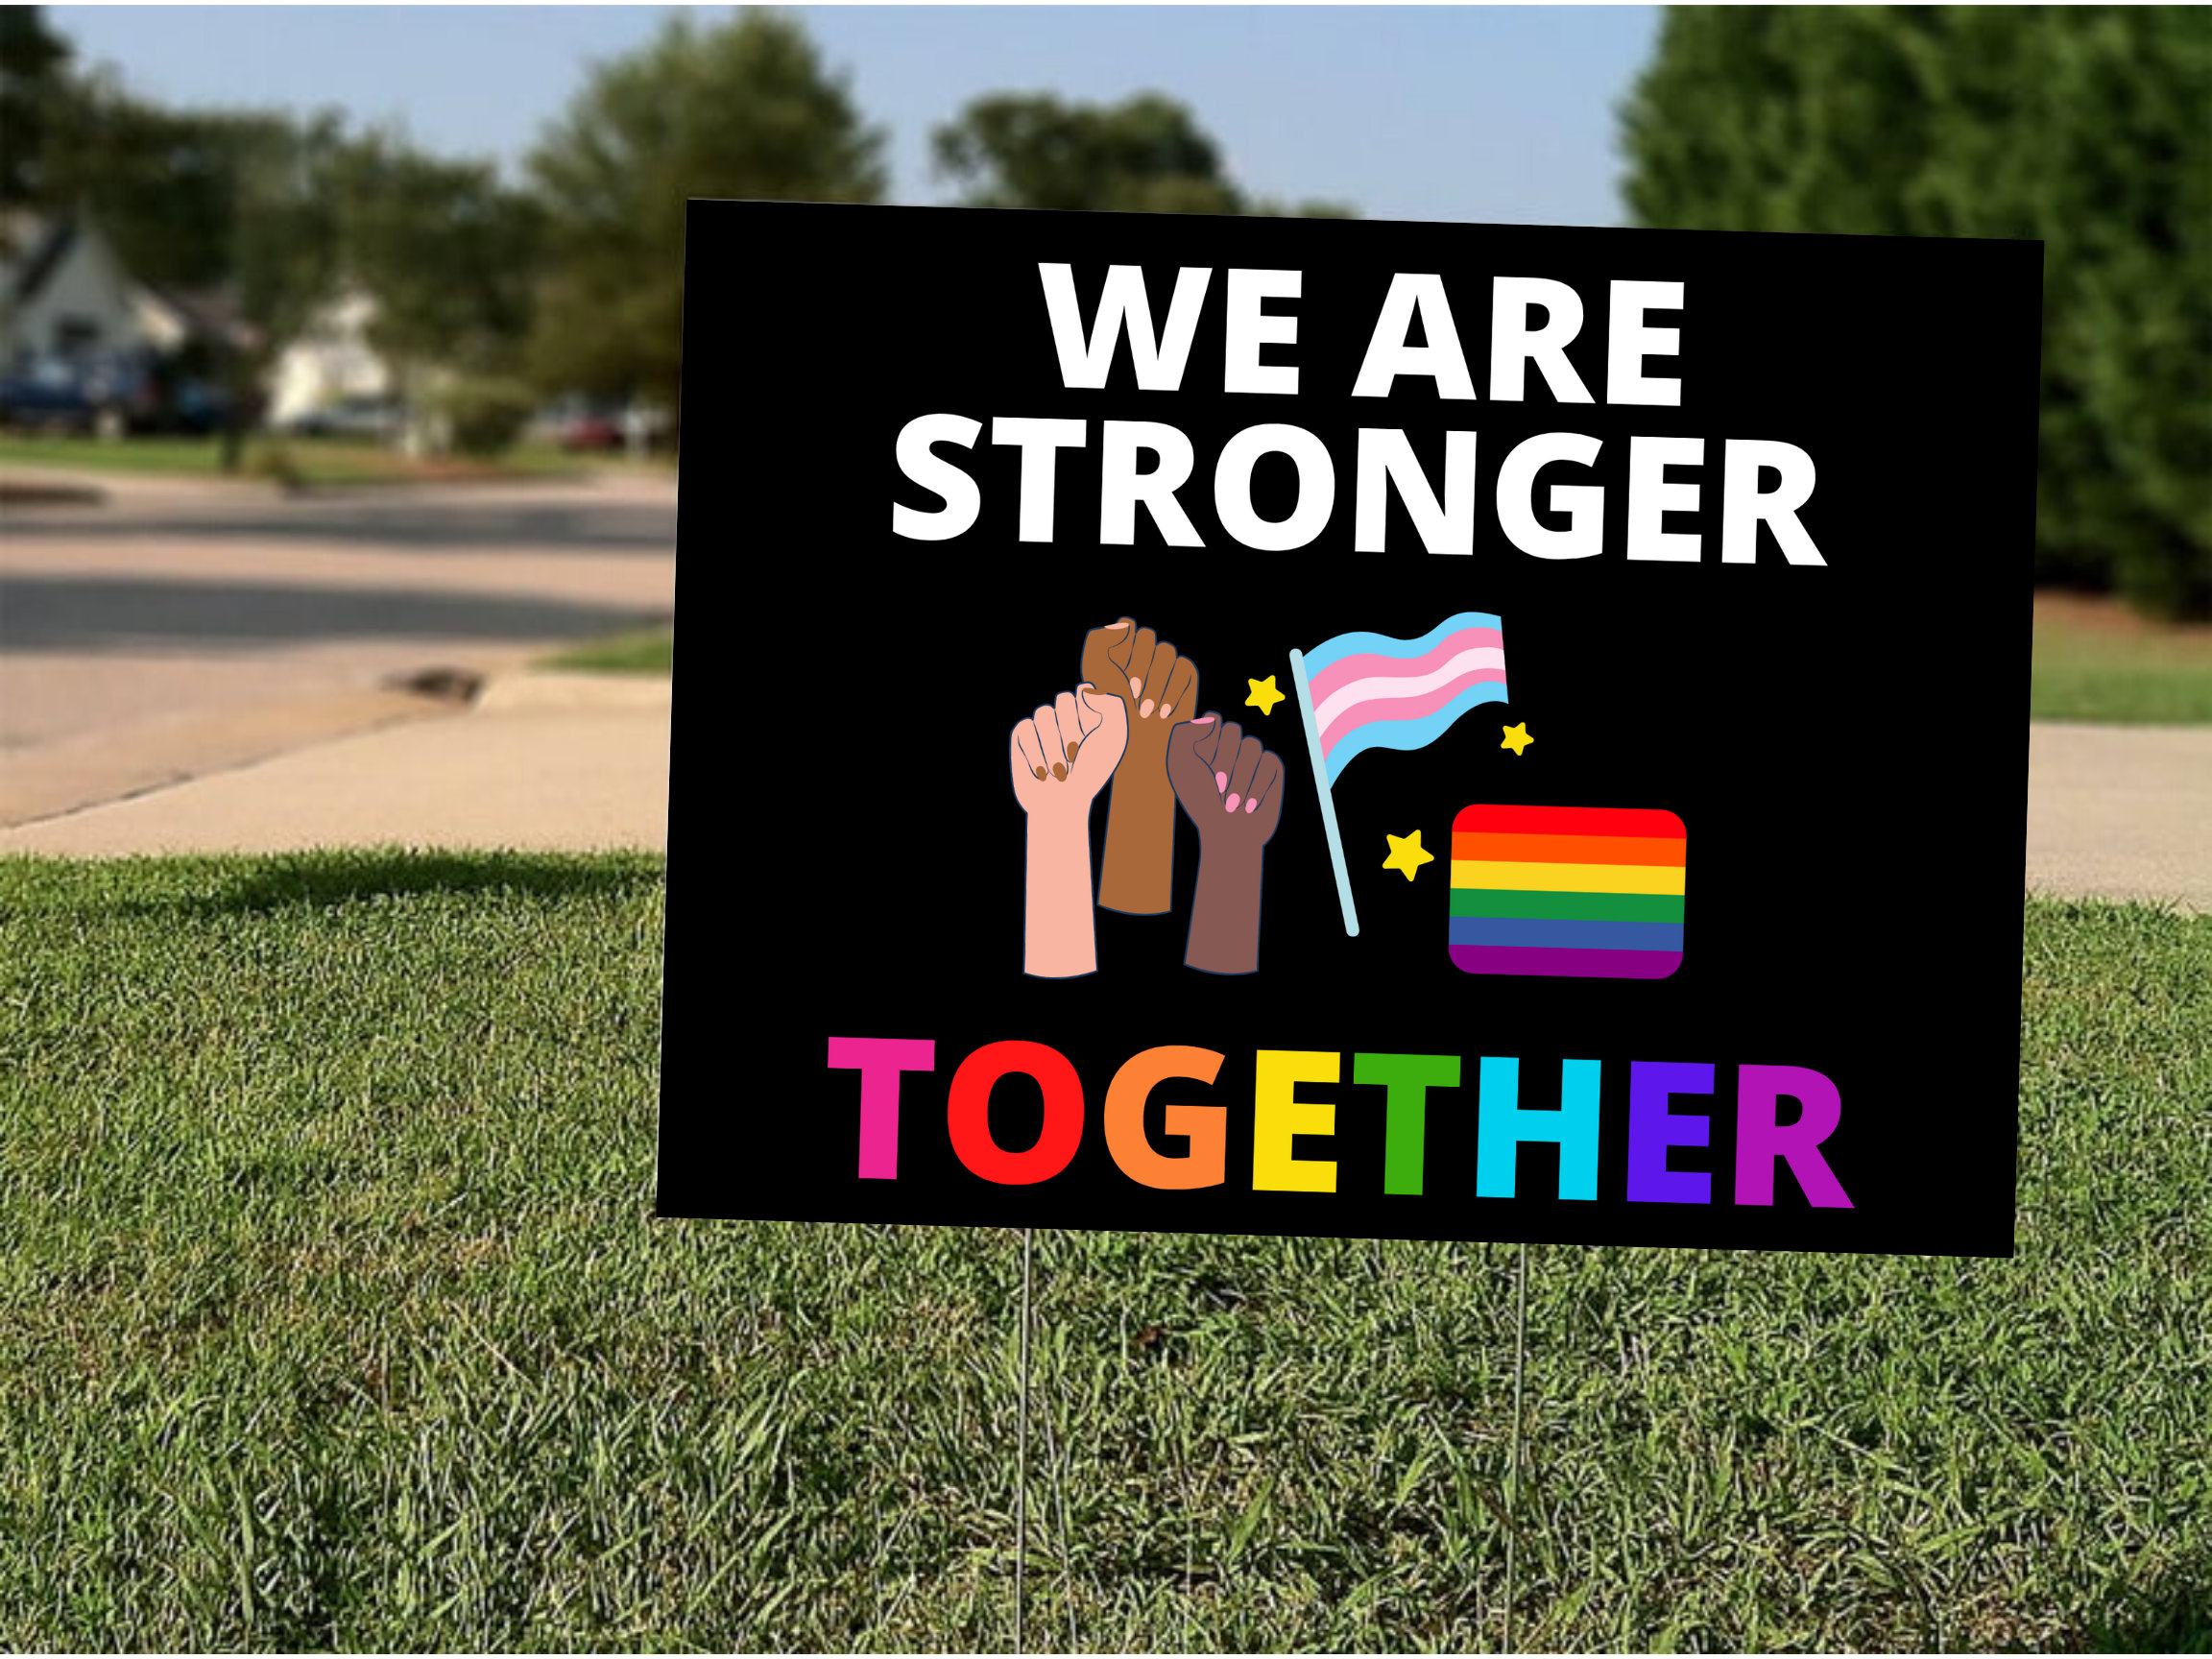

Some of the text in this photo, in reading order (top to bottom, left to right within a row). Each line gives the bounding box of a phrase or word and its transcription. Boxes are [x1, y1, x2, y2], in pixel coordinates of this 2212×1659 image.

[1038, 262, 1686, 407] WE ARE
[892, 413, 1829, 566] STRONGER
[827, 1036, 1855, 1210] TOGETHER
